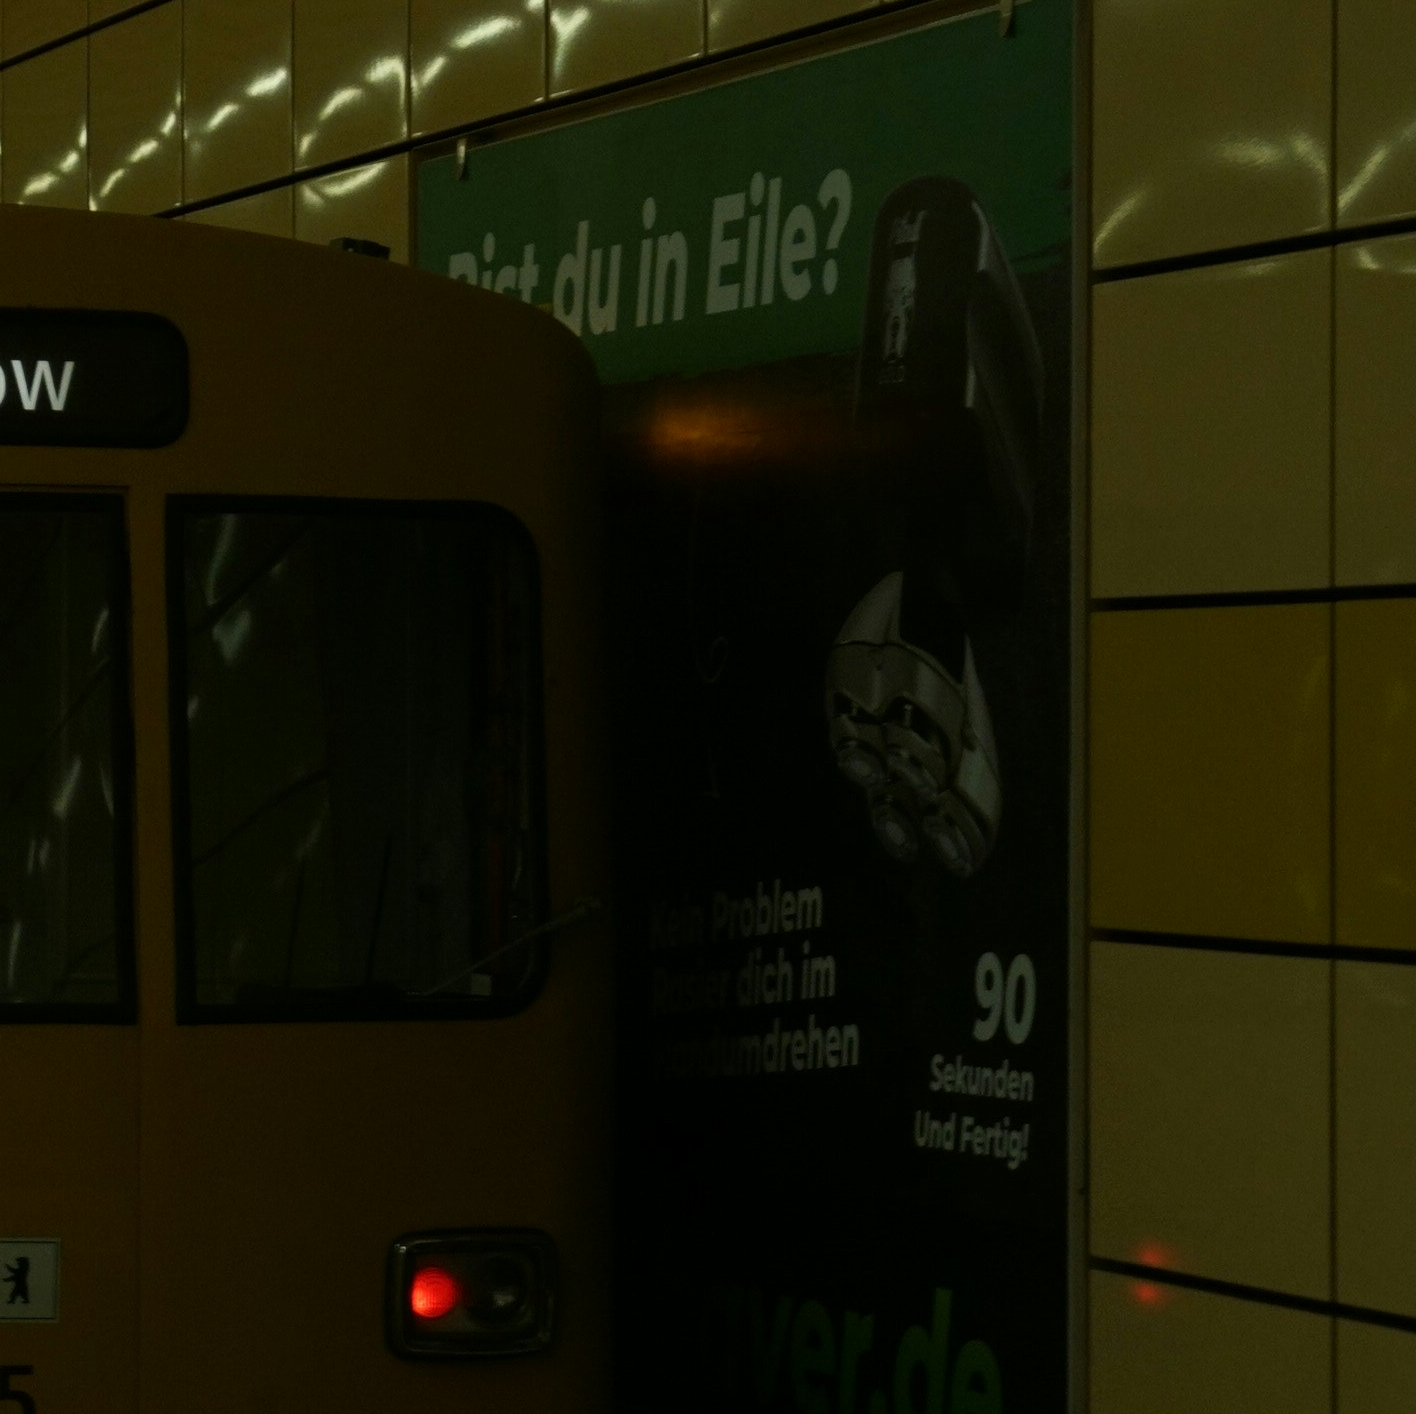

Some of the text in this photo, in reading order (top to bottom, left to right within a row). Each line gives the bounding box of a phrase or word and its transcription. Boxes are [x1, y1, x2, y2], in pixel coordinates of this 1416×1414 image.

[552, 220, 622, 337] du
[635, 197, 688, 327] in
[705, 168, 852, 315] Eile?
[711, 878, 824, 943] Problem
[735, 945, 793, 1007] dich
[800, 939, 836, 1000] im
[972, 951, 1036, 1045] 90
[929, 1053, 1034, 1102] Sekunden
[914, 1109, 1031, 1170] Und Fertig!
